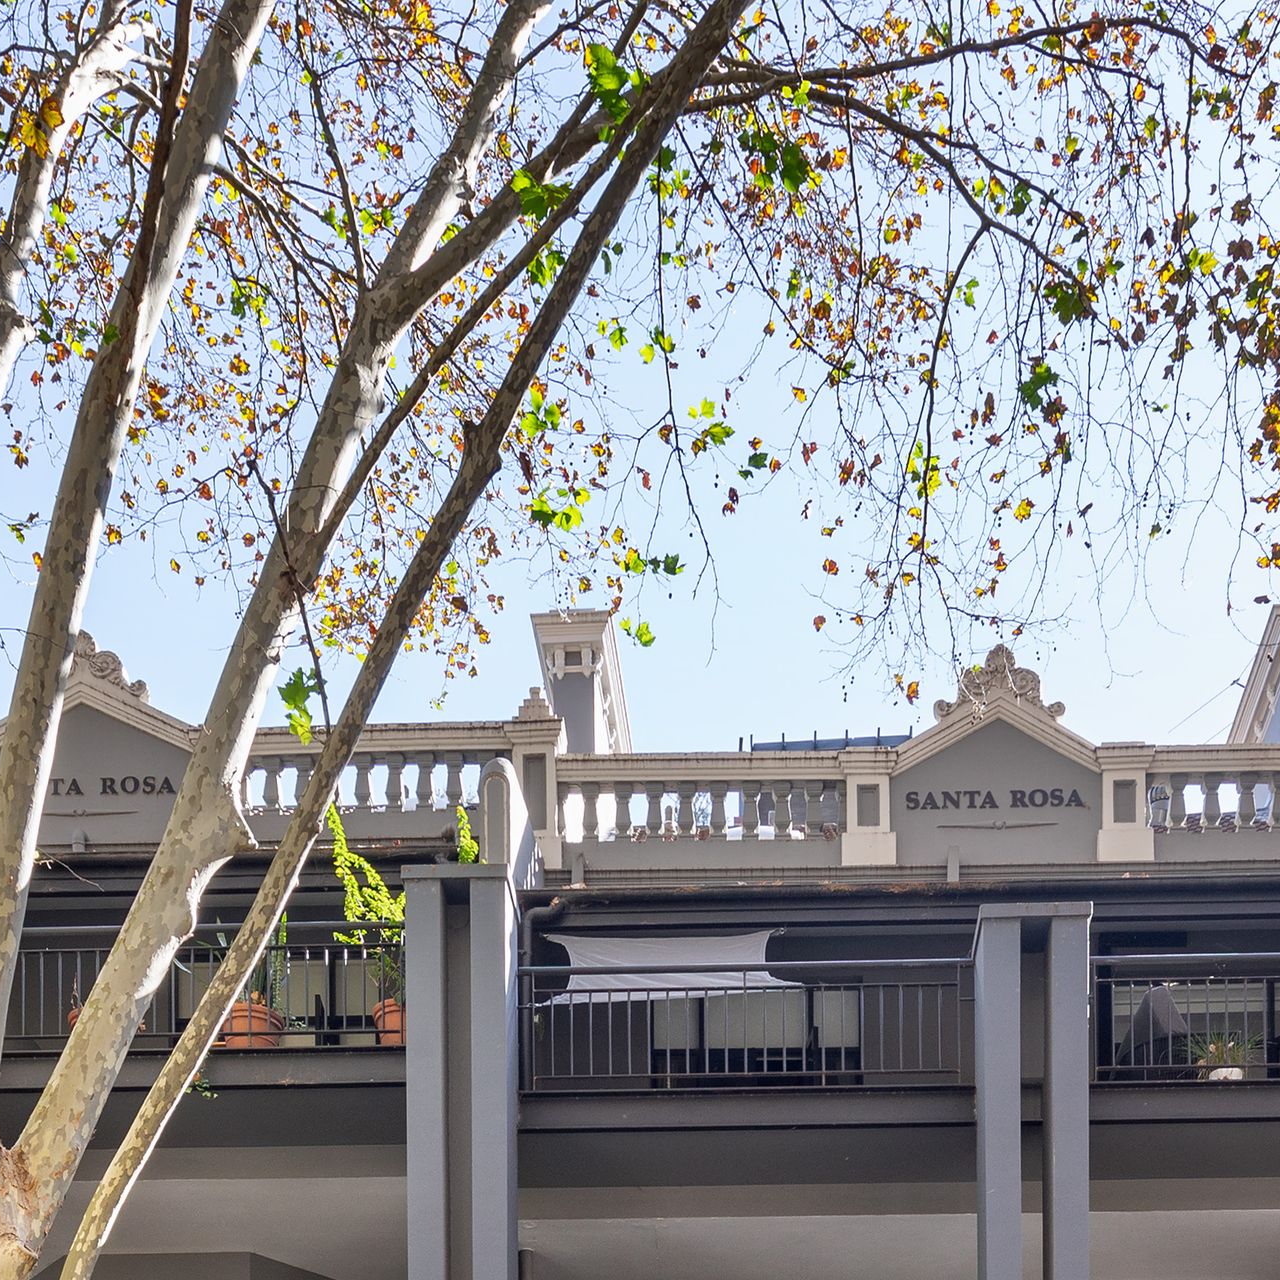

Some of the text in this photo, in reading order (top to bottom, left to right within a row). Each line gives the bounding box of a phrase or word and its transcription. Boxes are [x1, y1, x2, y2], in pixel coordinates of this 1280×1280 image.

[100, 776, 177, 796] ROSA
[905, 788, 1085, 811] SANTA ROSA
